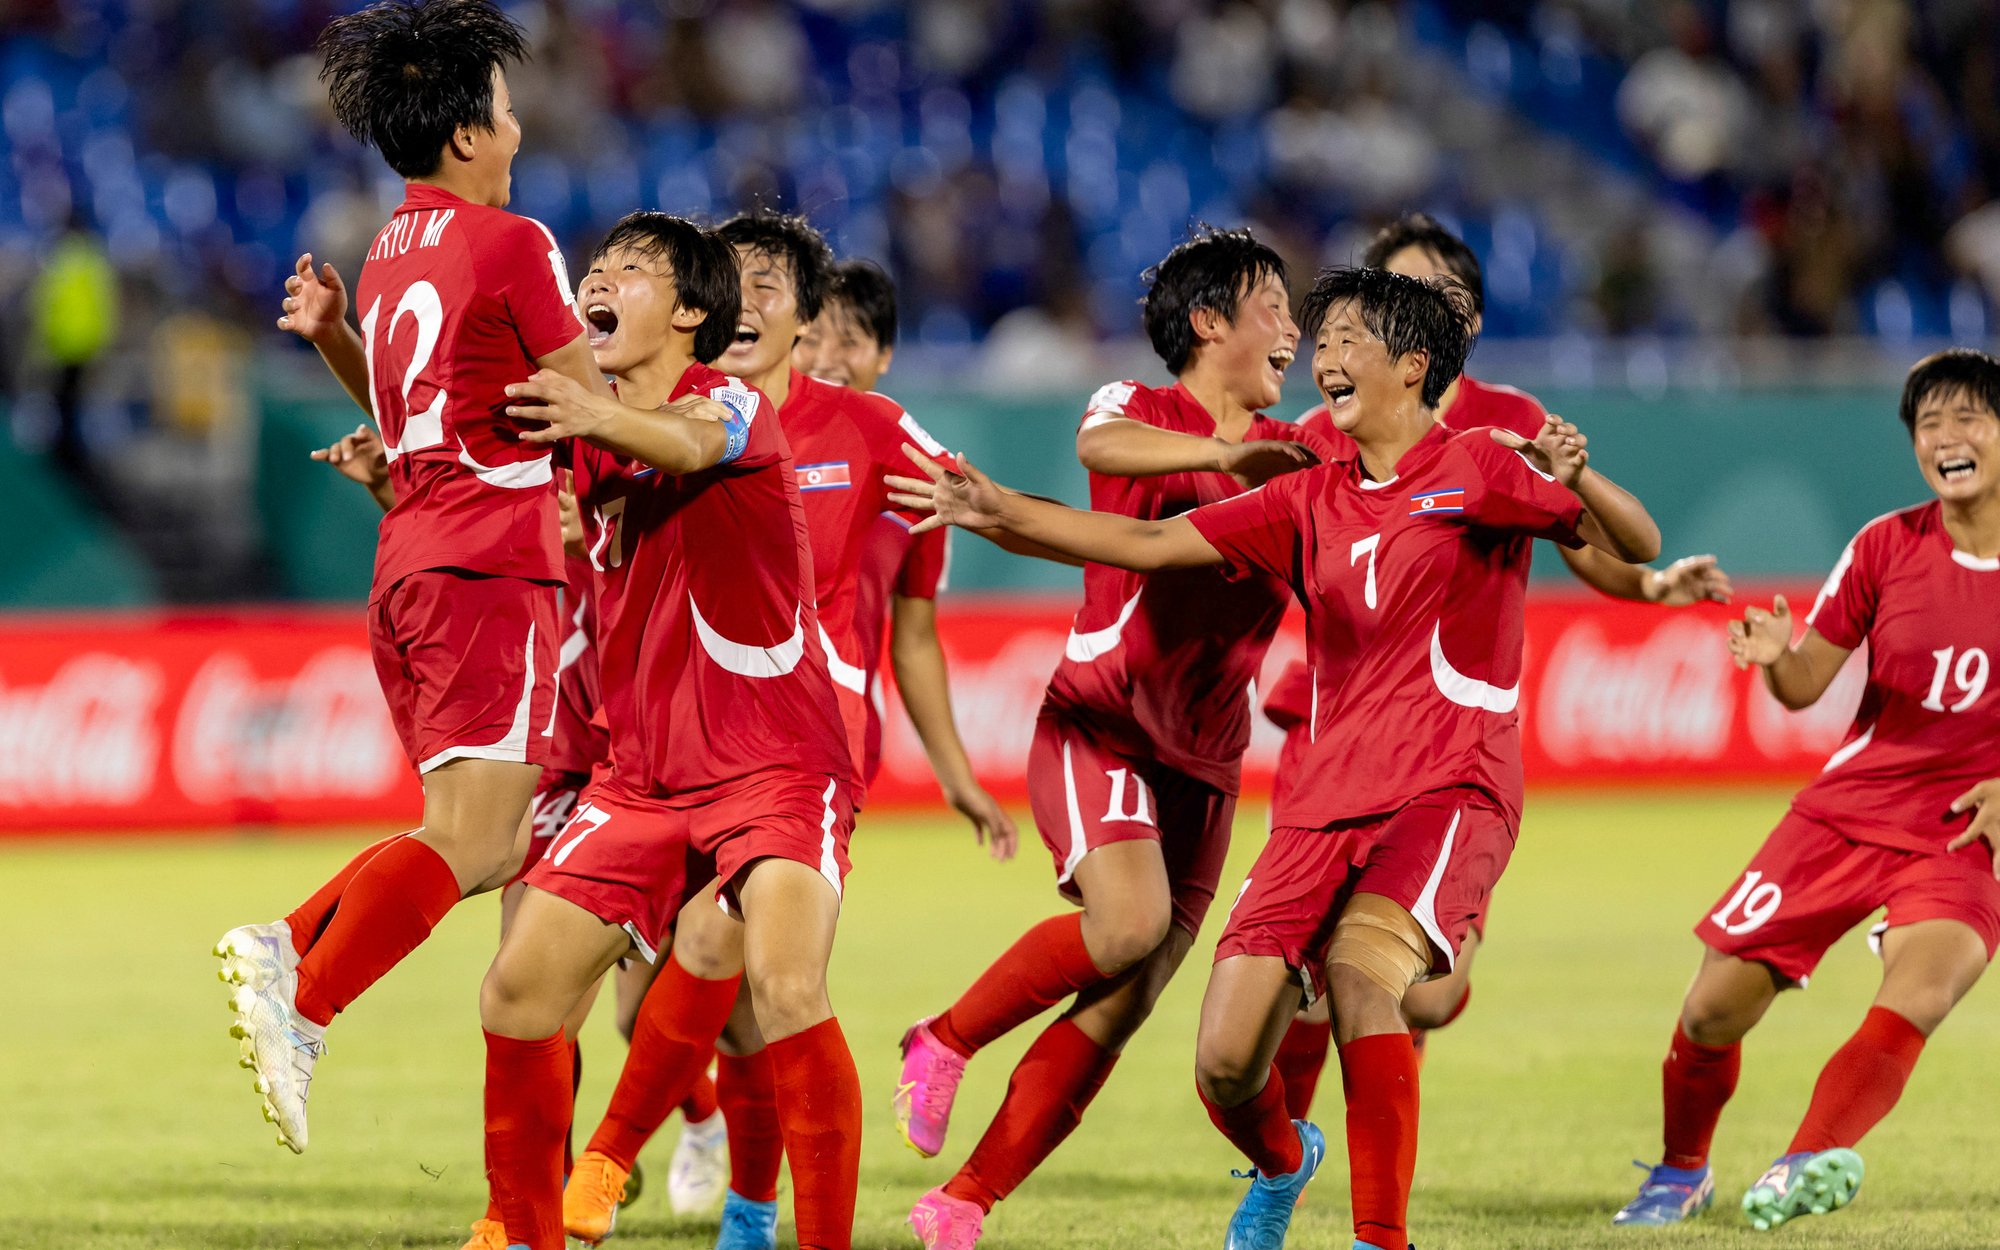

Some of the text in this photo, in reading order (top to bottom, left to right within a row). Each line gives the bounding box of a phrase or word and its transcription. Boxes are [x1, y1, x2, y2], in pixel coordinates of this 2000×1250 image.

[420, 209, 455, 248] MI
[361, 281, 448, 464] 12
[589, 496, 627, 572] 17
[1350, 533, 1380, 609] 7
[1922, 645, 1990, 713] 19
[1100, 768, 1154, 826] 11
[542, 801, 612, 867] 17
[1711, 870, 1783, 936] 19
